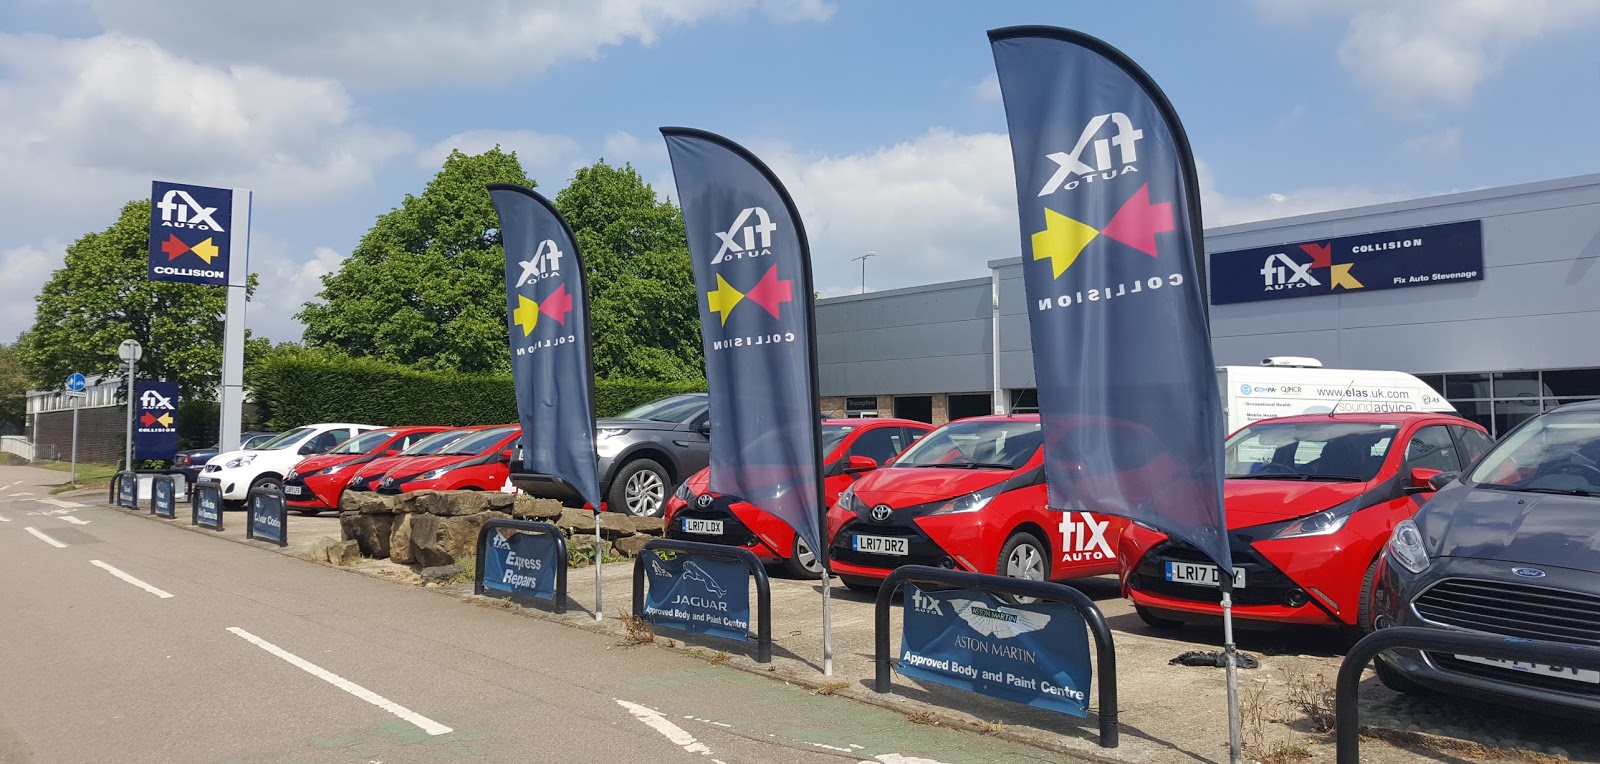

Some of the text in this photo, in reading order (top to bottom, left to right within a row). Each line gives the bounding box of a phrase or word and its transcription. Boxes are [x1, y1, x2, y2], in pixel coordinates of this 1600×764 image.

[157, 190, 225, 232] fix
[161, 221, 210, 231] AUTO
[1352, 238, 1423, 254] COLLISION
[153, 266, 224, 279] COLLISION
[1260, 252, 1321, 287] fix
[1393, 270, 1478, 285] Fix Auto Stevenage
[1264, 282, 1307, 292] AUTO
[140, 390, 175, 410] fix
[1316, 386, 1409, 399] www.elas.uk.com
[688, 521, 721, 533] LR17 LDX
[1059, 511, 1116, 559] fix
[860, 537, 904, 553] LR17 DRZ
[505, 550, 542, 571] Express
[1062, 551, 1104, 562] AUTO
[503, 568, 537, 589] Repairs
[1176, 564, 1208, 582] LR17
[1211, 568, 1239, 585] DY
[671, 595, 728, 612] JAGUAR
[912, 589, 944, 616] fix
[915, 607, 938, 615] AUTO
[645, 604, 673, 617] Approved
[674, 609, 690, 620] Body
[692, 613, 705, 621] and
[706, 614, 721, 625] Paint
[972, 606, 1018, 623] ASTON MARTIN
[954, 634, 1036, 664] ASTON MARTIN
[903, 650, 1085, 701] Approved Body and Paint Centre
